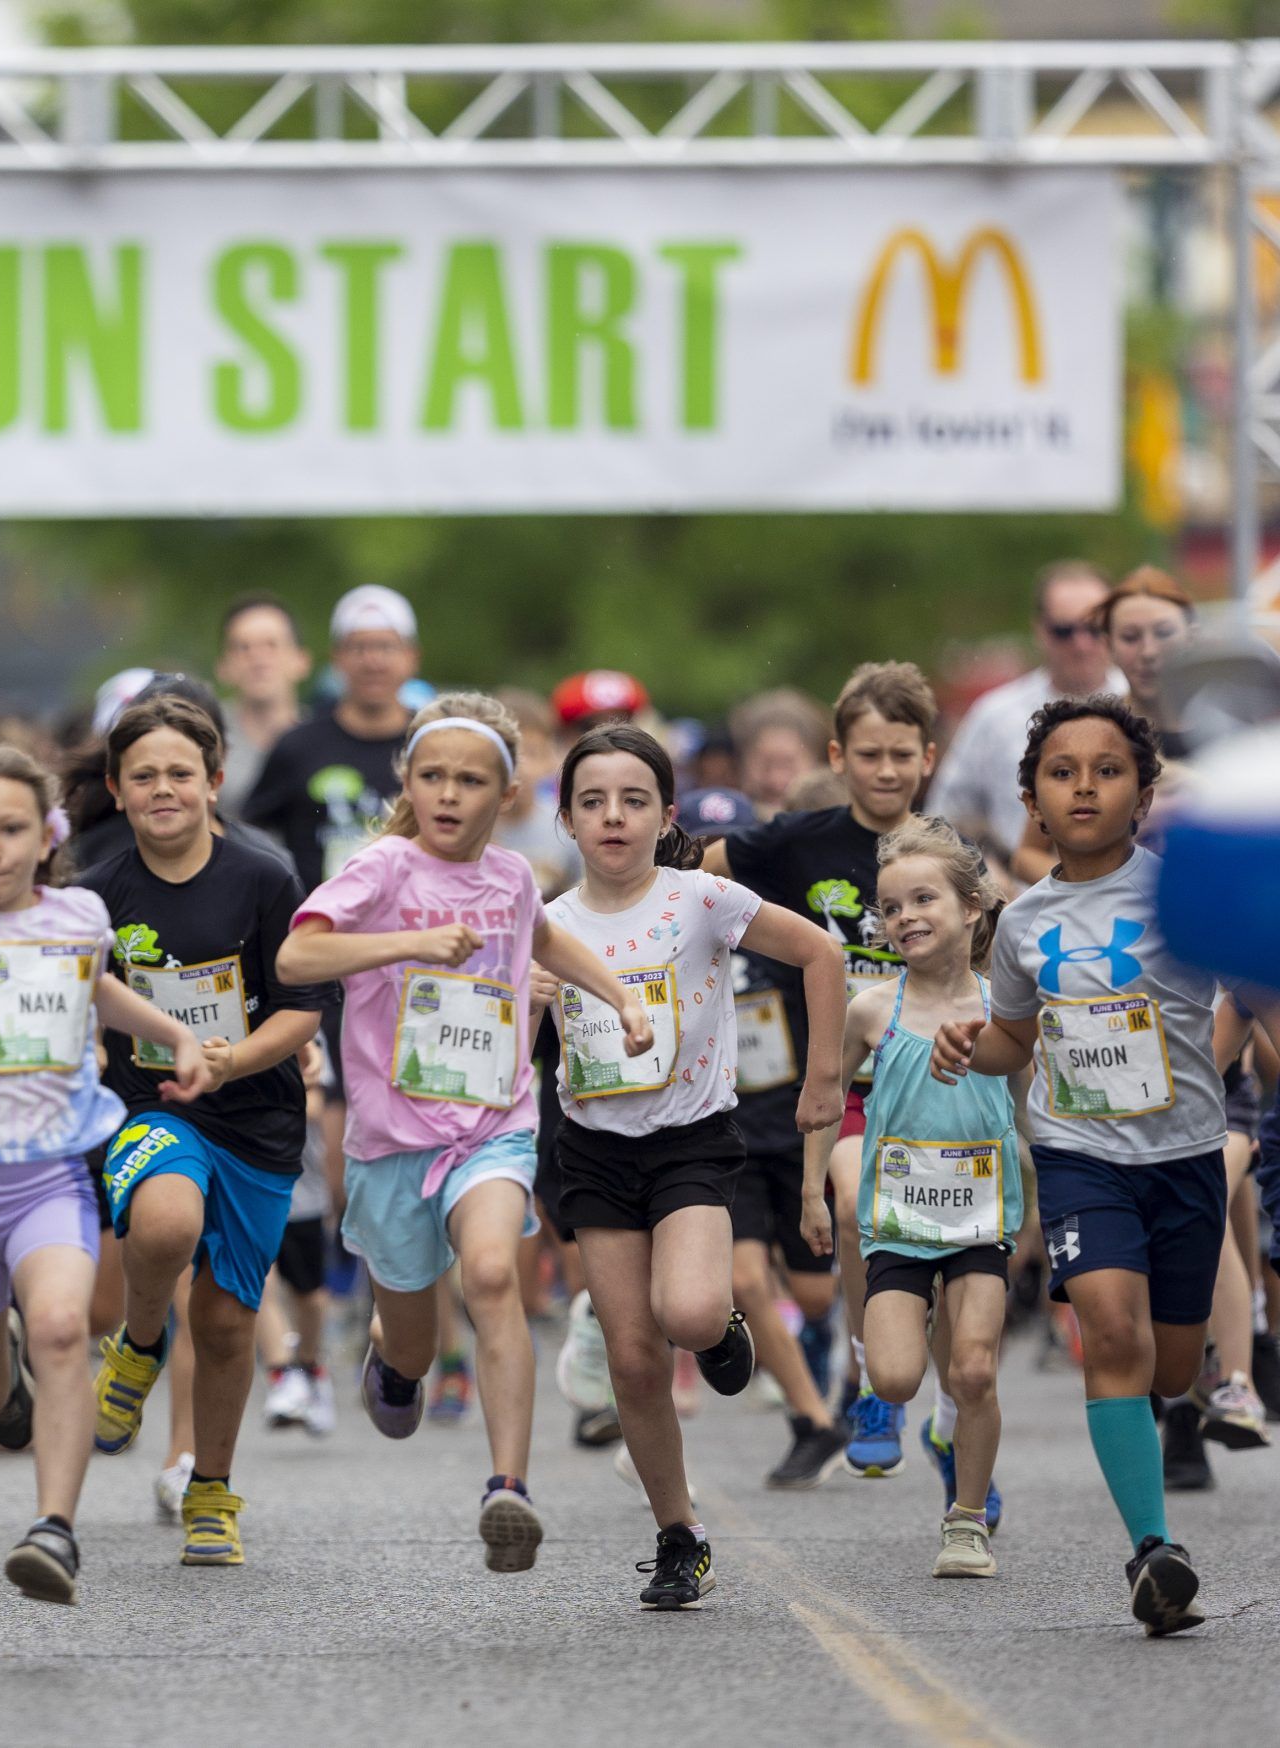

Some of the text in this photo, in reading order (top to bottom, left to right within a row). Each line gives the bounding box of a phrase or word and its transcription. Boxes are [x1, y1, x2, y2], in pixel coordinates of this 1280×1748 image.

[211, 240, 744, 436] START
[217, 974, 232, 991] 1K
[632, 975, 642, 983] 11,
[643, 973, 663, 982] 2023
[19, 991, 68, 1013] NAYA
[648, 983, 665, 1002] 1K
[1092, 1003, 1113, 1013] JUNE
[1114, 1003, 1124, 1011] 11,
[1130, 1010, 1149, 1029] 1K
[440, 1025, 492, 1052] PIPER
[653, 1056, 661, 1073] 1
[1069, 1045, 1128, 1068] SIMON
[1141, 1082, 1149, 1098] 1
[942, 1149, 963, 1157] JUNE
[975, 1157, 991, 1176] 1K
[904, 1185, 973, 1207] HARPER
[974, 1225, 980, 1239] 1
